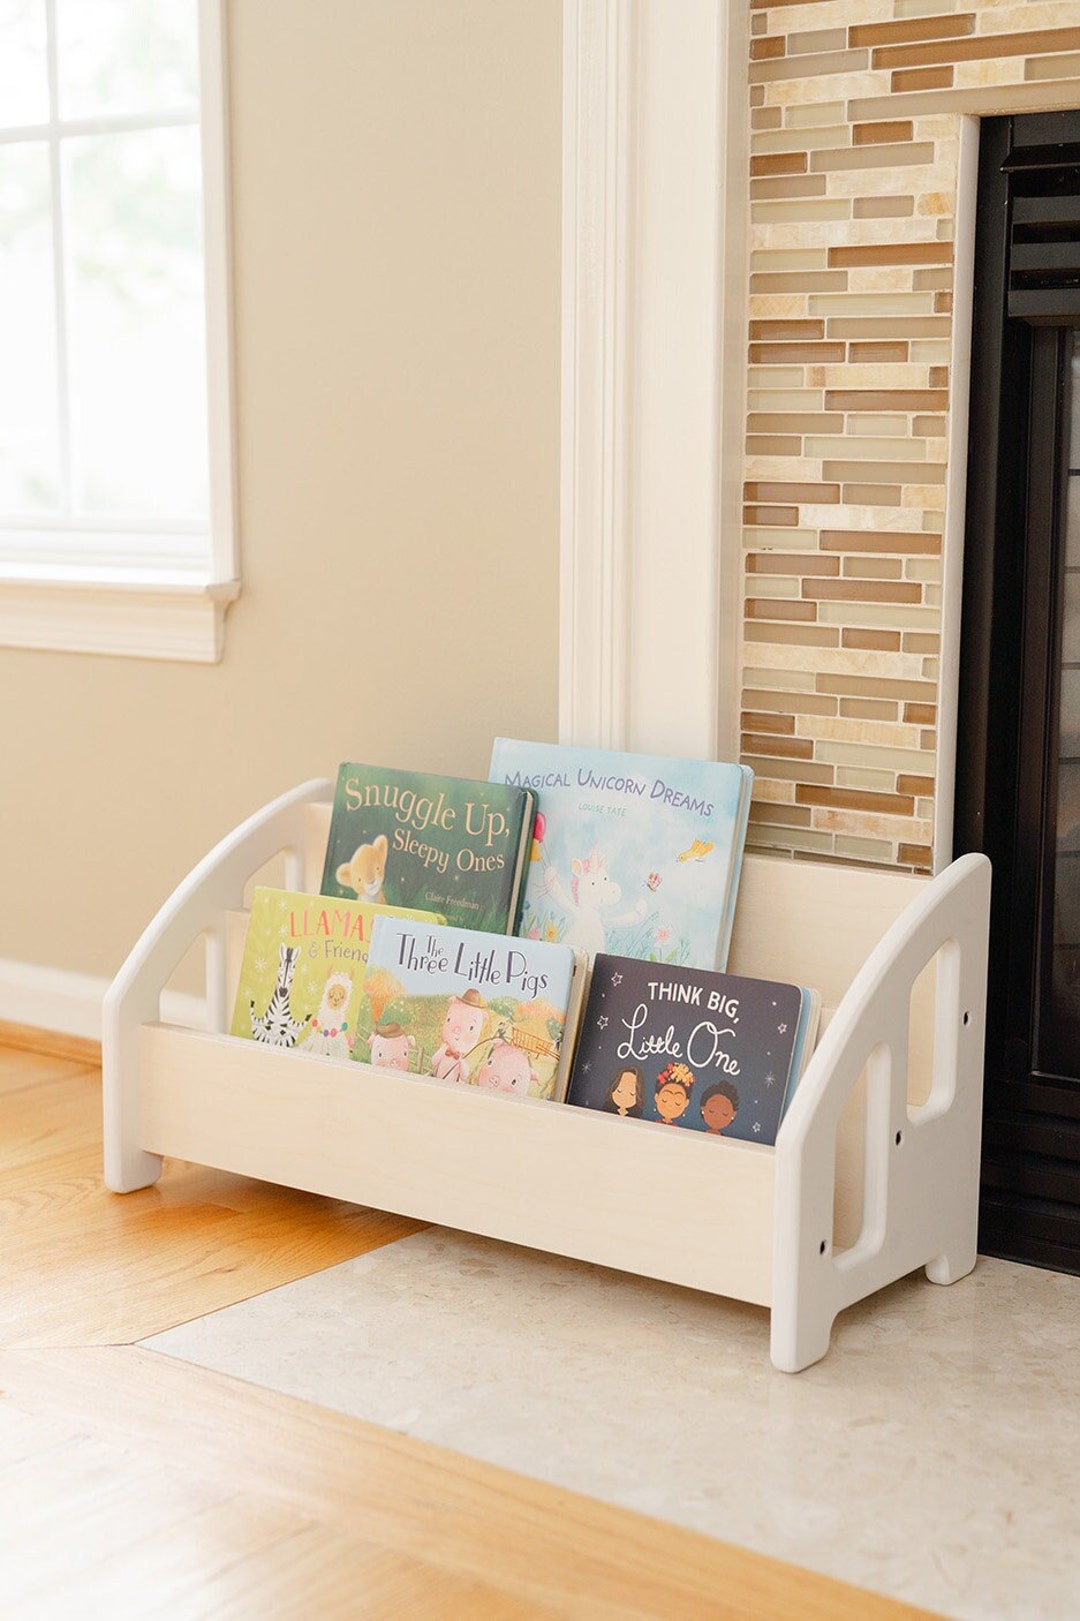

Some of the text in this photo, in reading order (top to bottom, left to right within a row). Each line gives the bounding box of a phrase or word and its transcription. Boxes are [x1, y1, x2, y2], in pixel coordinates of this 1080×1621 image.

[345, 778, 510, 847] Snuggle Up,
[505, 768, 714, 817] MAGICAL UNICORN DREAMS
[578, 803, 627, 817] LOUISE TATE
[392, 828, 505, 874] Sleepy Ones
[290, 909, 374, 943] LLAMA
[426, 935, 445, 958] The
[396, 933, 548, 999] Three Little Pigs
[648, 982, 740, 1024] THINK BIG,
[617, 1003, 740, 1076] Little One
